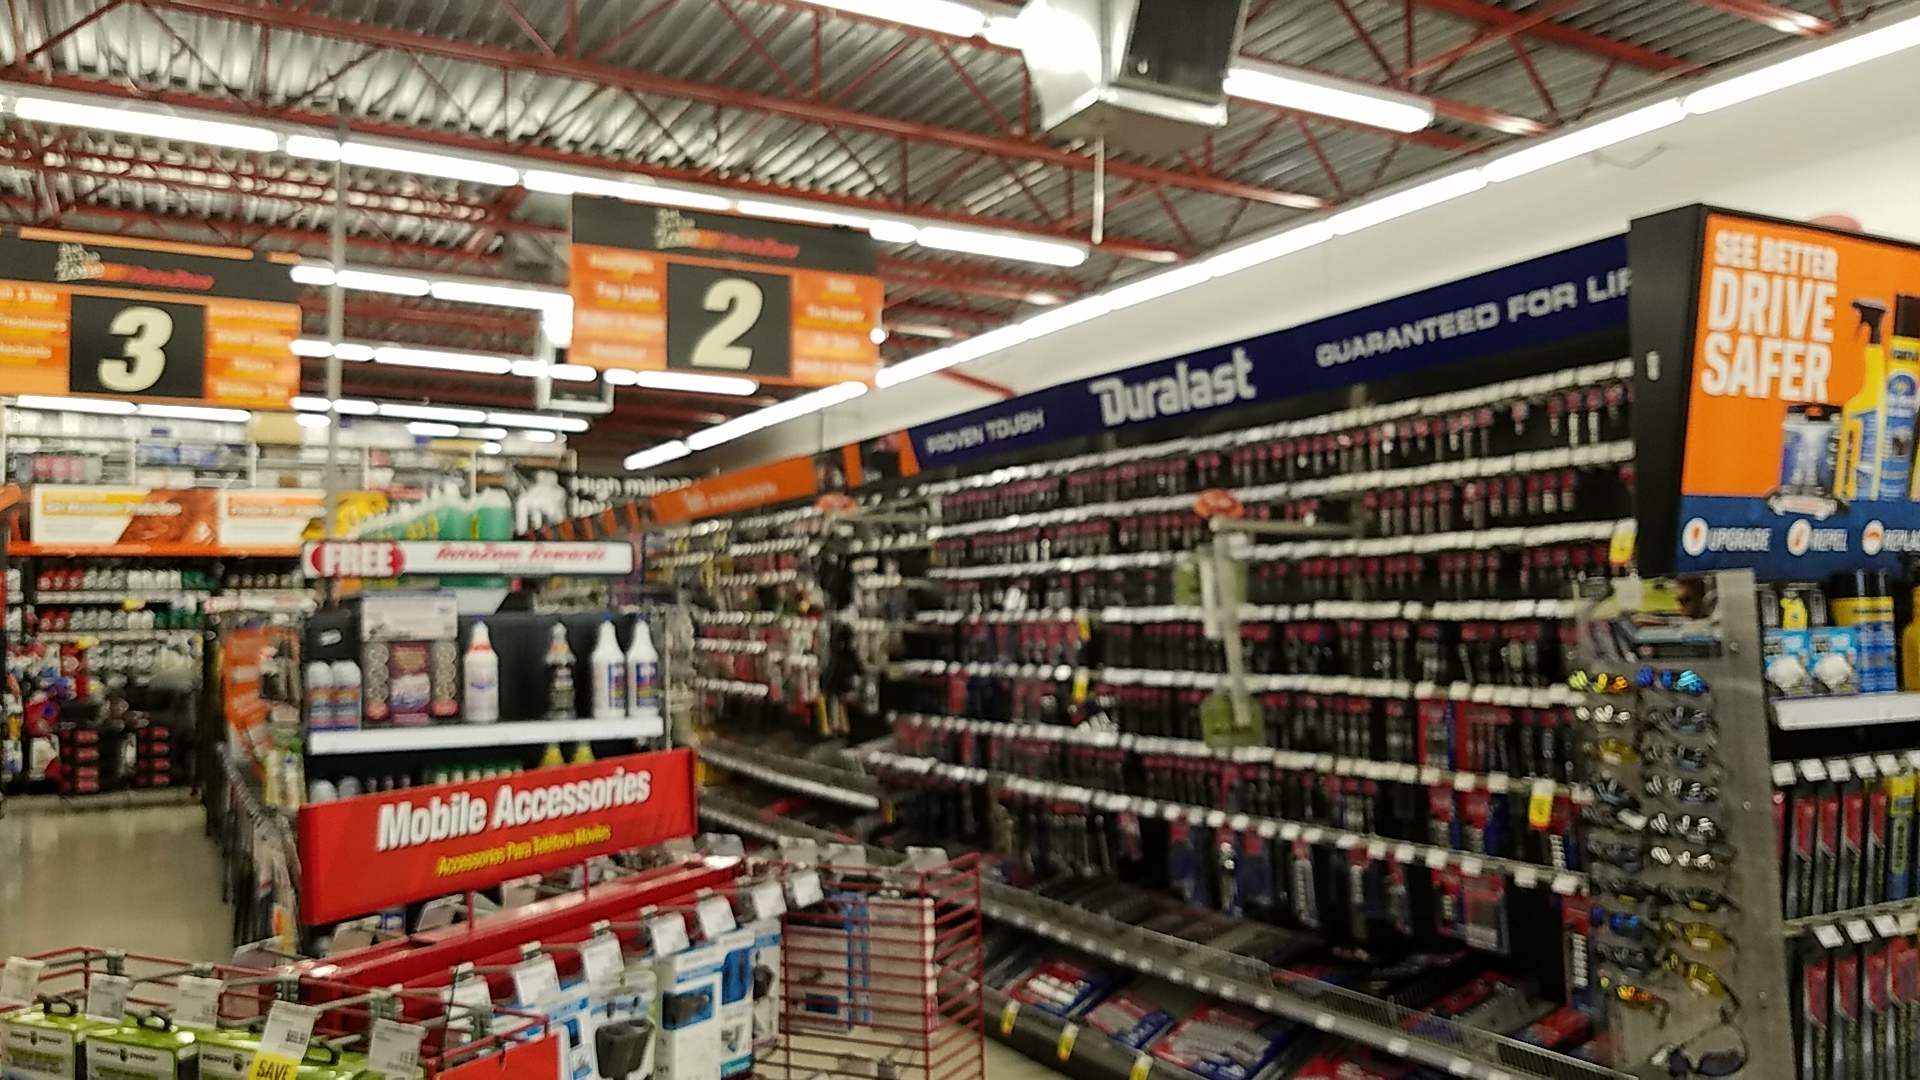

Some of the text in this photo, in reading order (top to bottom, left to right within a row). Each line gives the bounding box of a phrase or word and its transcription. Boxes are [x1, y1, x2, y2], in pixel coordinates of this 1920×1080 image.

[1714, 229, 1839, 281] SEE BETTER
[691, 278, 763, 370] 2
[1315, 266, 1632, 367] GUARANTEED FOR LIF
[1707, 268, 1838, 344] DRIVE
[98, 305, 174, 393] 3
[1701, 332, 1832, 402] SAFER
[1089, 347, 1257, 426] Duralast
[925, 408, 1046, 454] PROVEN TOUGH
[321, 541, 395, 577] FREE
[1708, 527, 1772, 552] UPGRADE
[376, 766, 652, 852] Mobile Accessories
[507, 841, 533, 861] Para
[256, 1058, 292, 1080] SAVE
